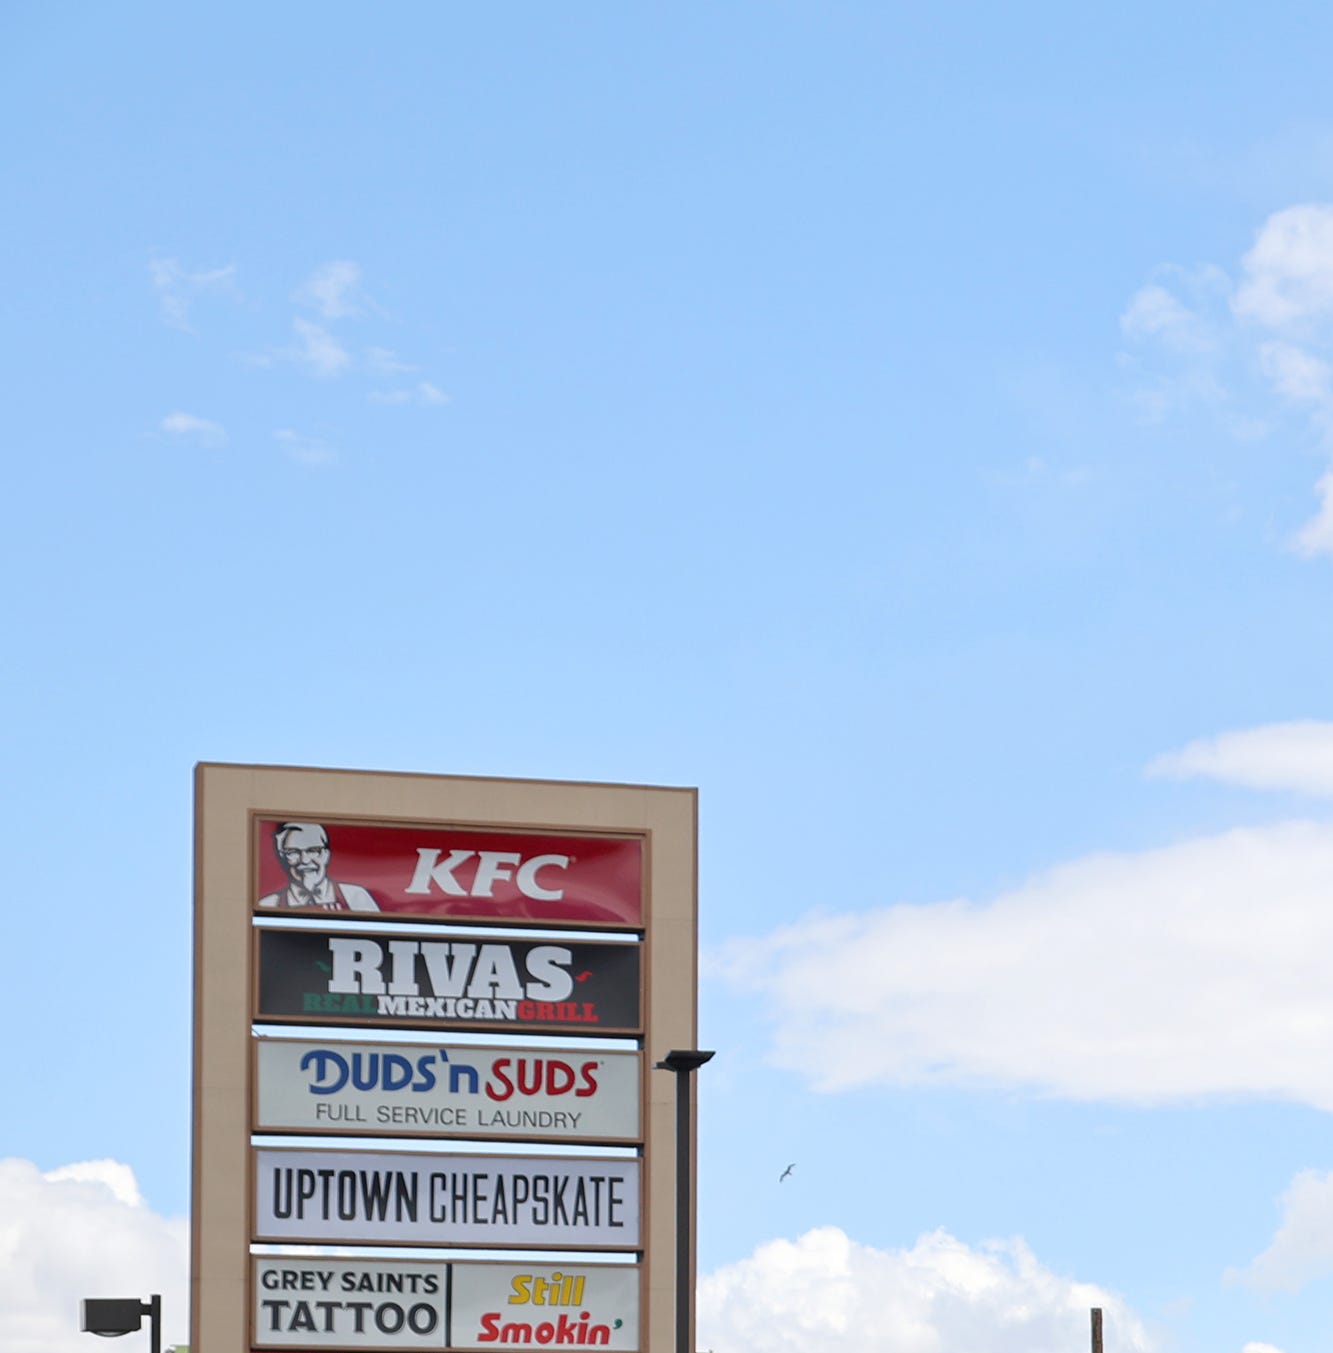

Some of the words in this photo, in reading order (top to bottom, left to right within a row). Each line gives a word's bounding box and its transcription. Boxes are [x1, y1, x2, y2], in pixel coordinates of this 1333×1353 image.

[405, 847, 569, 901] KFC
[327, 937, 573, 1003] RIVAS
[485, 1058, 599, 1102] SUDS
[315, 1103, 366, 1122] FULL
[376, 1105, 467, 1126] SERVICE
[478, 1109, 582, 1129] LAUNDRY
[273, 1167, 418, 1222] UPTOWN
[429, 1172, 624, 1227] CHEAPSKATE
[261, 1269, 333, 1292] GREY
[341, 1272, 439, 1294] SAINTS
[508, 1271, 586, 1306] Still
[261, 1299, 438, 1336] TATTOO
[477, 1310, 624, 1345] Smokin'
